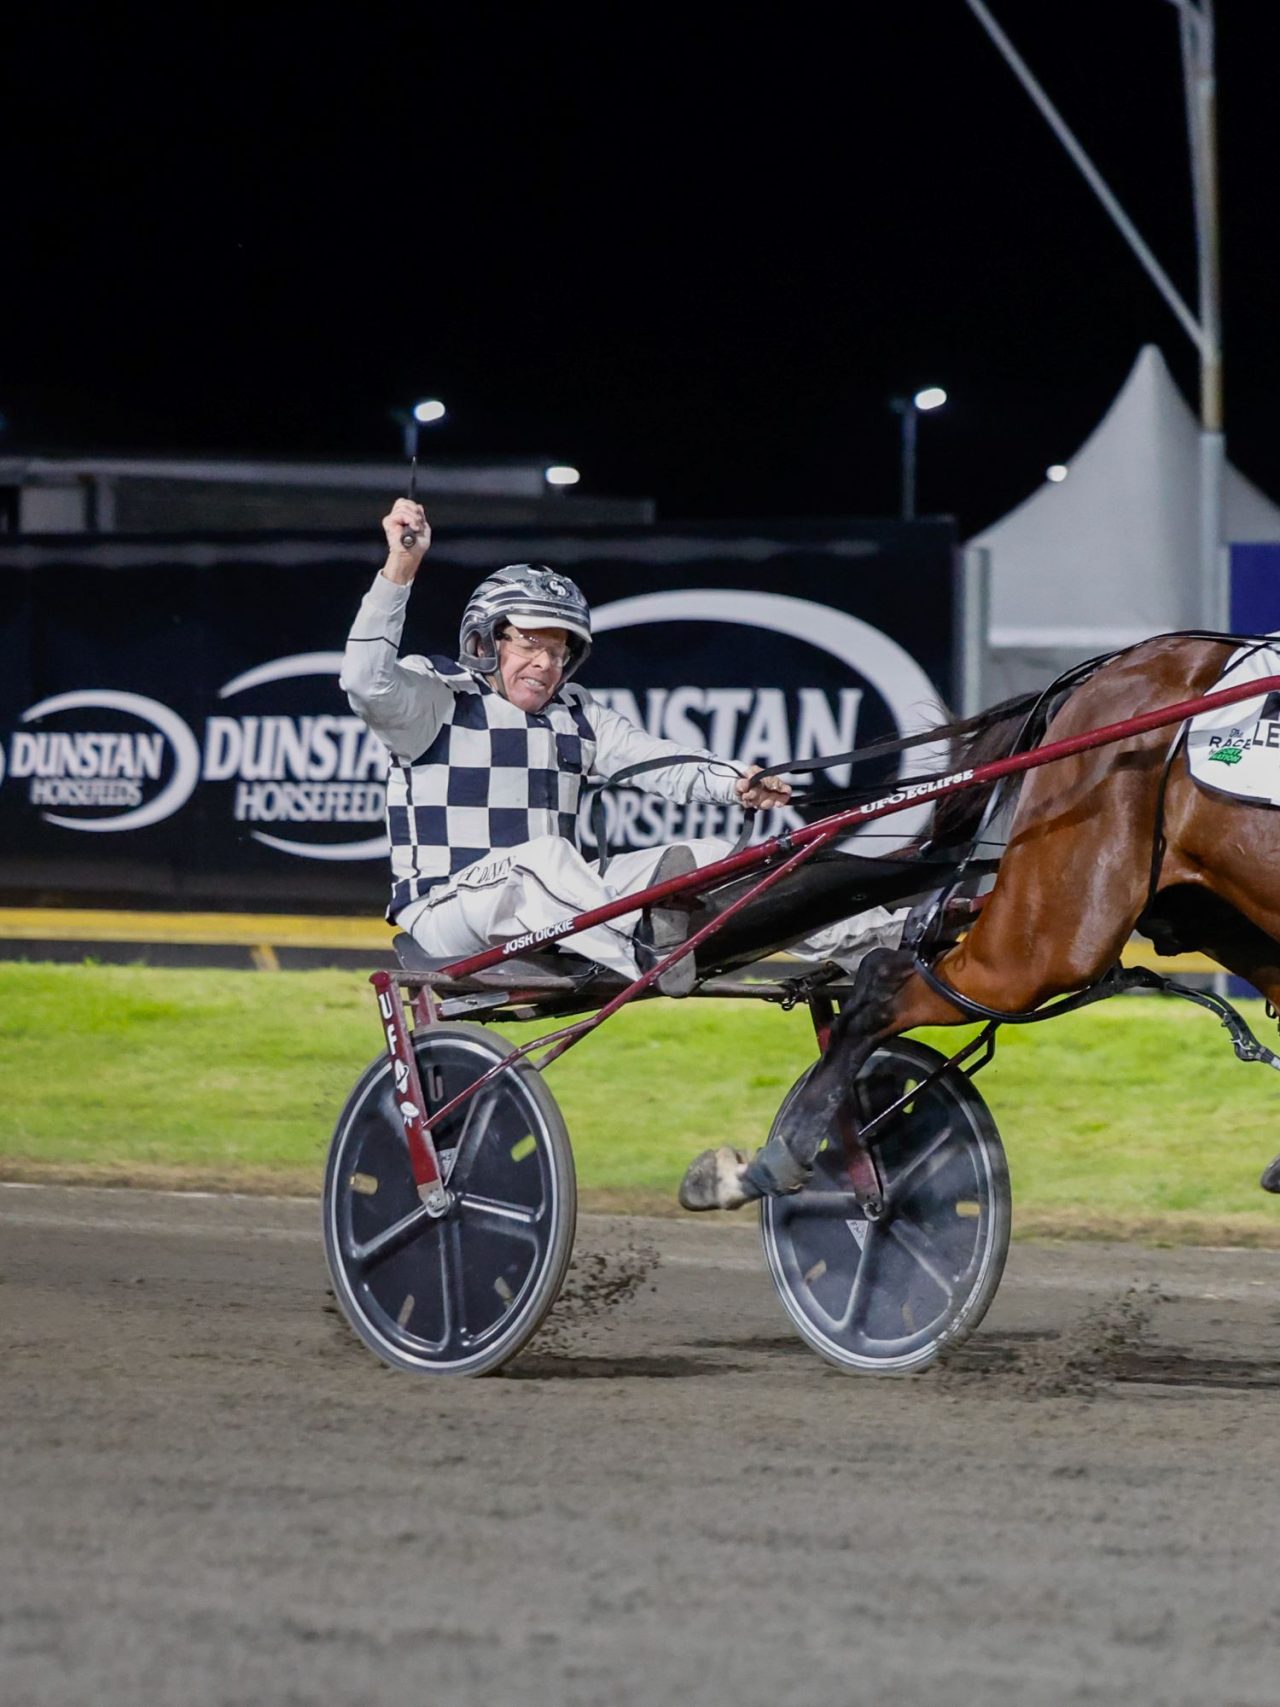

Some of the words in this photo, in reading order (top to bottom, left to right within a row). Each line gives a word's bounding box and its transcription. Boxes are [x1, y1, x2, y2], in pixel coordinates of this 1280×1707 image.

[9, 731, 164, 780] DUNSTAN
[203, 714, 388, 782] DUNSTA
[1208, 735, 1252, 750] RACE
[31, 777, 143, 806] HORSEFEEDS
[234, 780, 388, 822] HORSEFEED
[860, 793, 906, 814] UFO
[906, 769, 975, 799] ECLIPSE
[502, 931, 534, 955] JOSH
[534, 918, 575, 943] DICKIE
